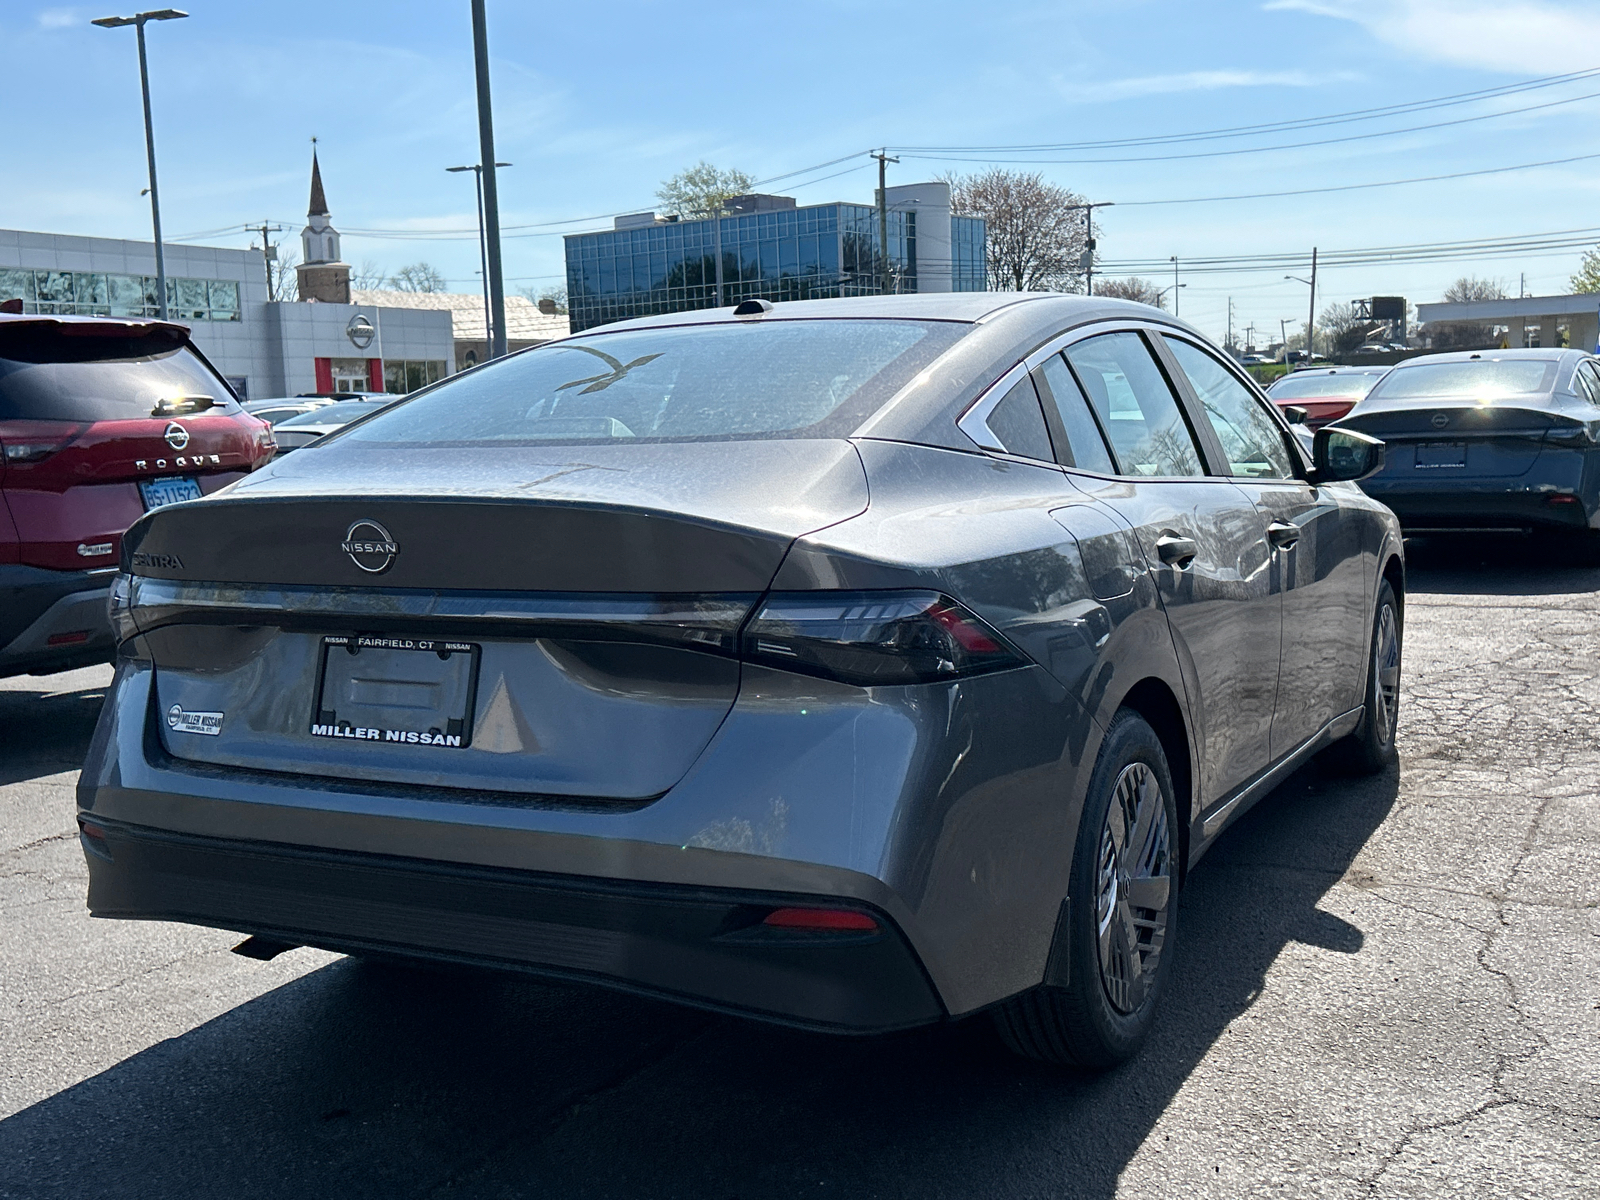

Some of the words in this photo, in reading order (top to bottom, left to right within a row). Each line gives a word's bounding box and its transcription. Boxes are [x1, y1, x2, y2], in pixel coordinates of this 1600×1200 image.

[135, 454, 220, 470] ROGUE
[341, 543, 396, 553] NISSAN
[133, 552, 185, 569] SENTRA
[325, 636, 349, 644] NISSAN
[358, 637, 415, 649] FAIRFIELD,
[419, 641, 435, 650] CT
[445, 642, 471, 651] NISSAN
[181, 713, 201, 725] MILLER
[202, 715, 222, 728] NISSAN
[311, 724, 380, 740] MILLER
[385, 730, 461, 747] NISSAN
